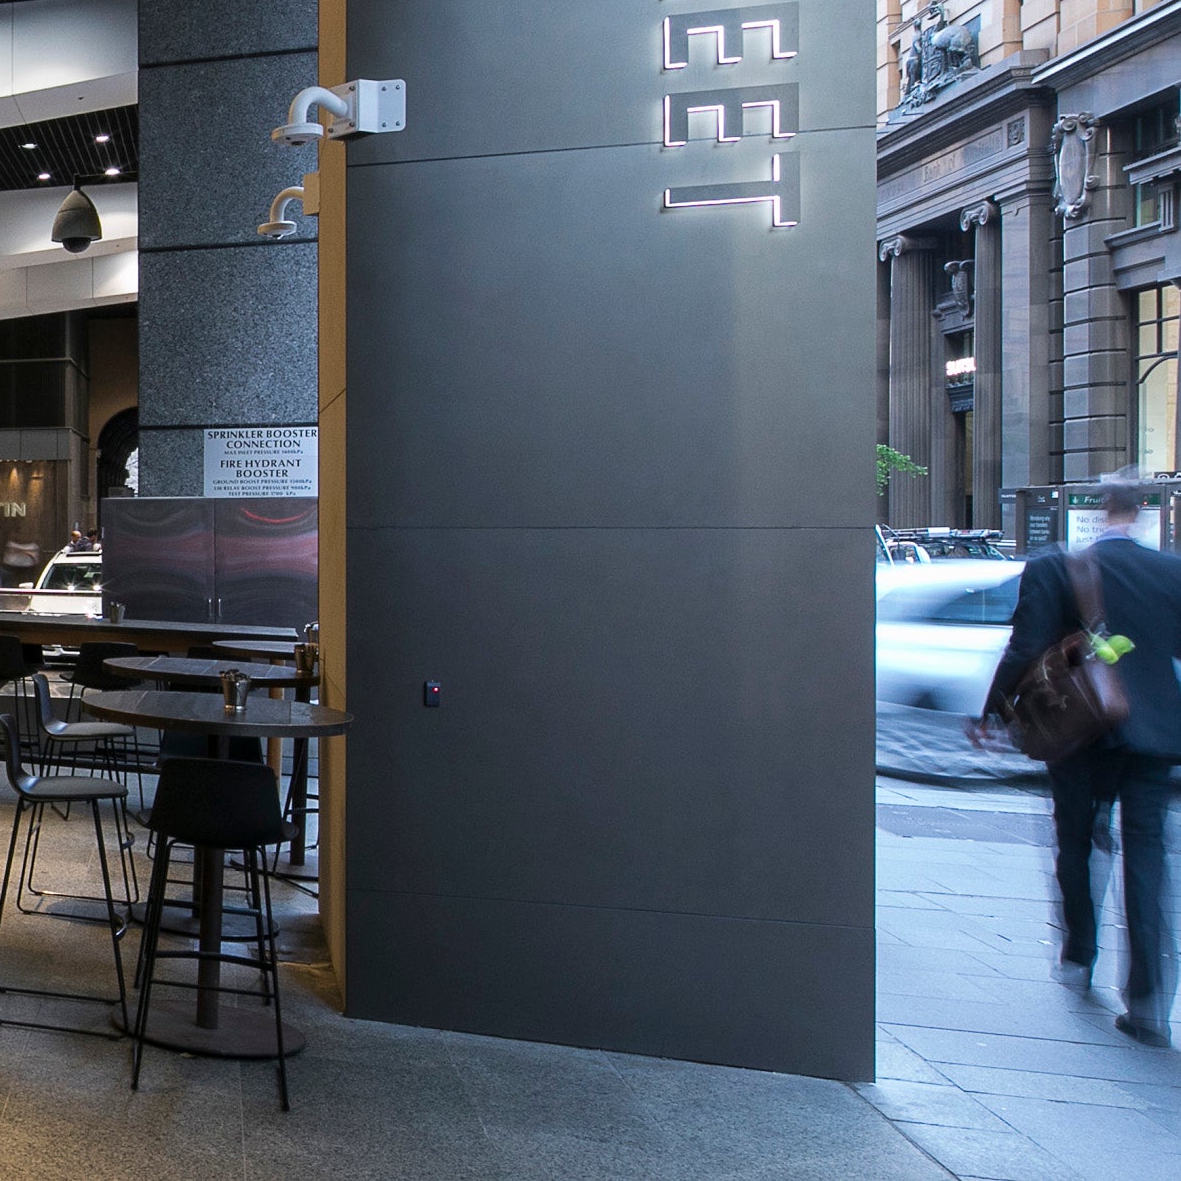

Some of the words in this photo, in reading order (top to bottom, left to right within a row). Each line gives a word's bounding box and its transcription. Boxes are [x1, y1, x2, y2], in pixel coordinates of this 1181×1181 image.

[207, 430, 264, 439] SPRINKLER
[266, 429, 317, 439] BOOSTER
[226, 440, 301, 449] CONNECTION
[220, 460, 242, 468] FIRE
[245, 459, 302, 468] HYDRANT
[236, 469, 289, 478] BOOSTER
